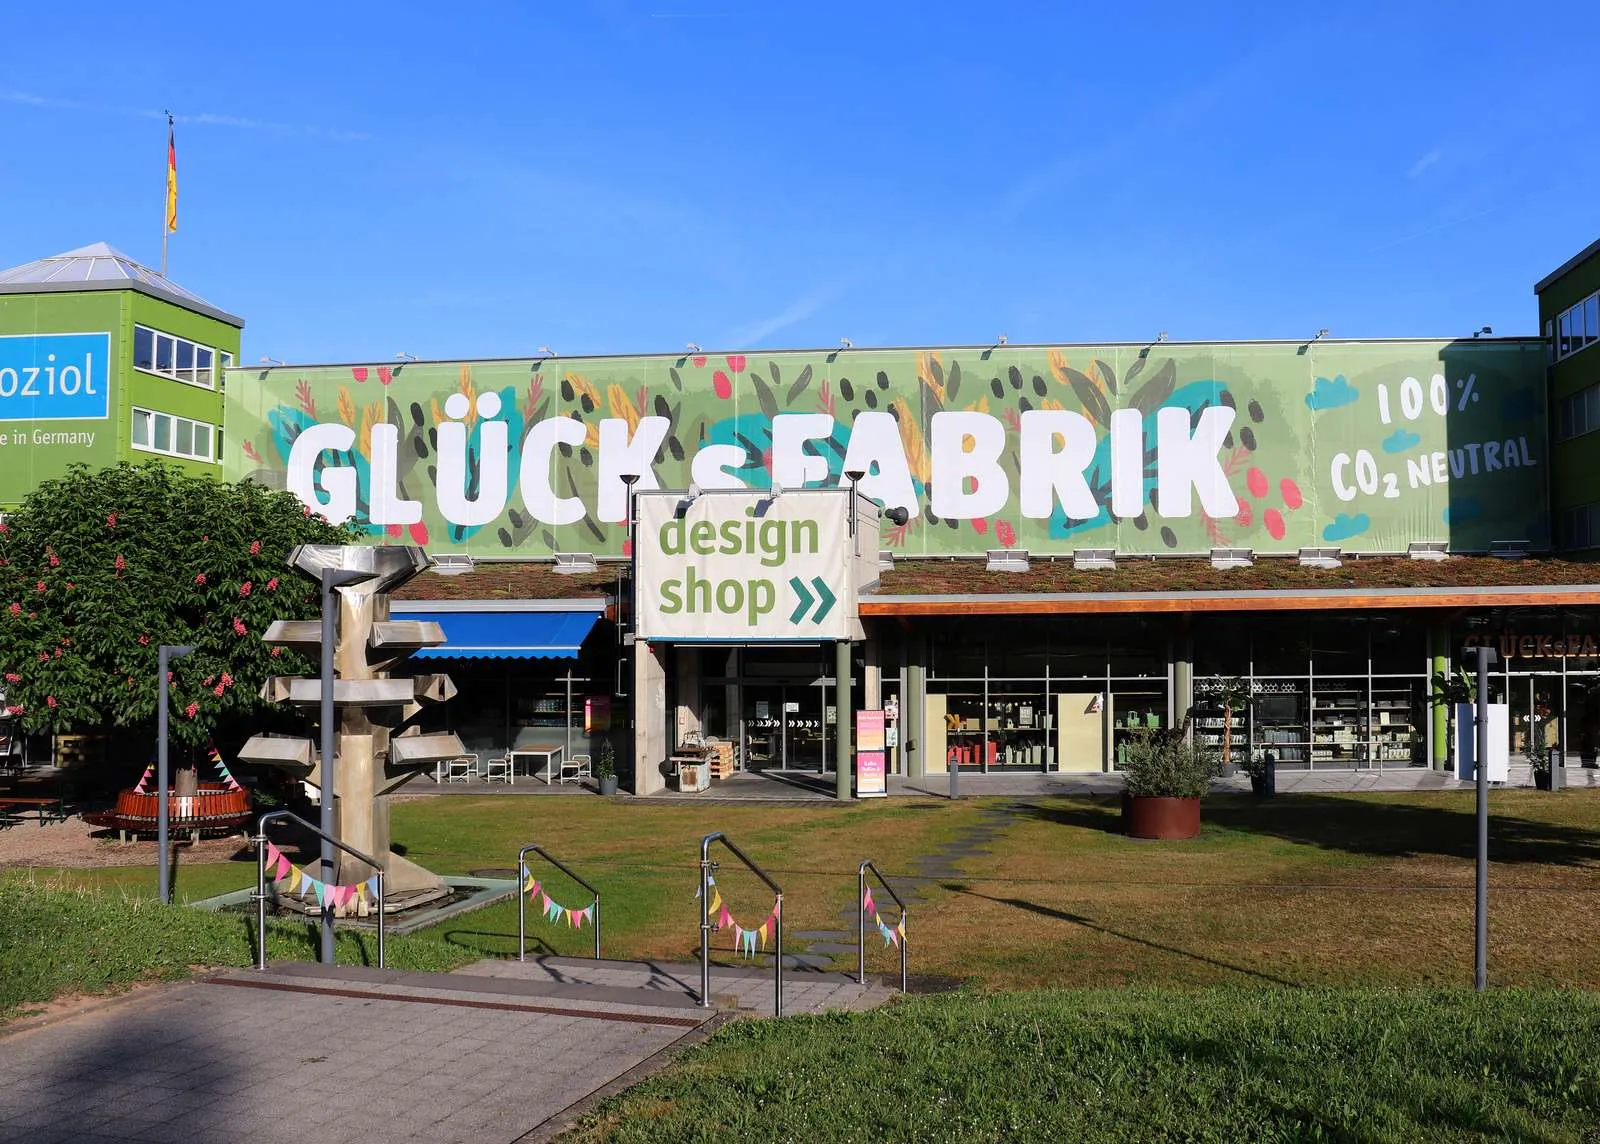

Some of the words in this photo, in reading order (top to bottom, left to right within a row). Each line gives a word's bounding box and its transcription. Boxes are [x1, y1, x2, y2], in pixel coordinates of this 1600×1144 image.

[1378, 373, 1479, 424] 100%
[14, 429, 26, 444] in
[33, 429, 95, 447] Germany
[1407, 436, 1537, 488] NEUTRAL
[659, 506, 819, 567] design
[659, 566, 776, 625] shop
